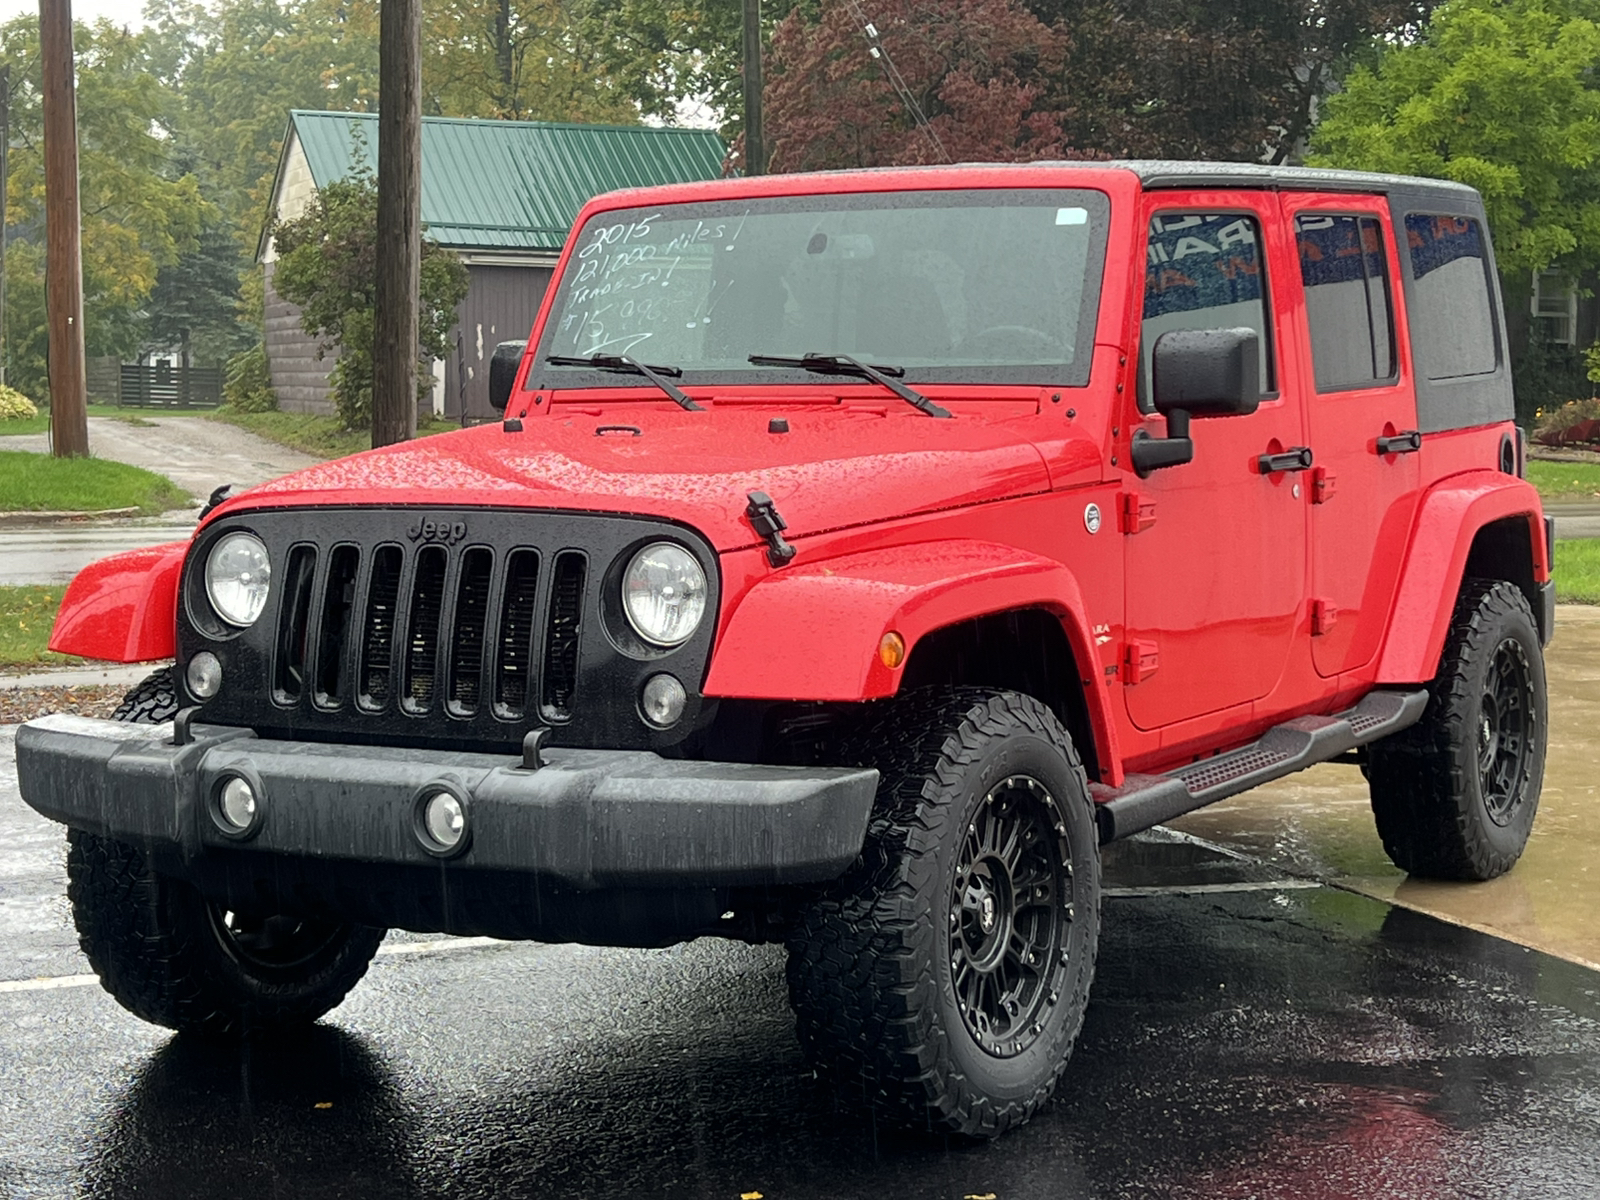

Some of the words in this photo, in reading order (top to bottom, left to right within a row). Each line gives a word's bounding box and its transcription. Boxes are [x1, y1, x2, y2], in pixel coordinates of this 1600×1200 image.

[578, 213, 661, 259] 2015
[570, 244, 656, 288] 121,000
[406, 516, 467, 546] Jeep
